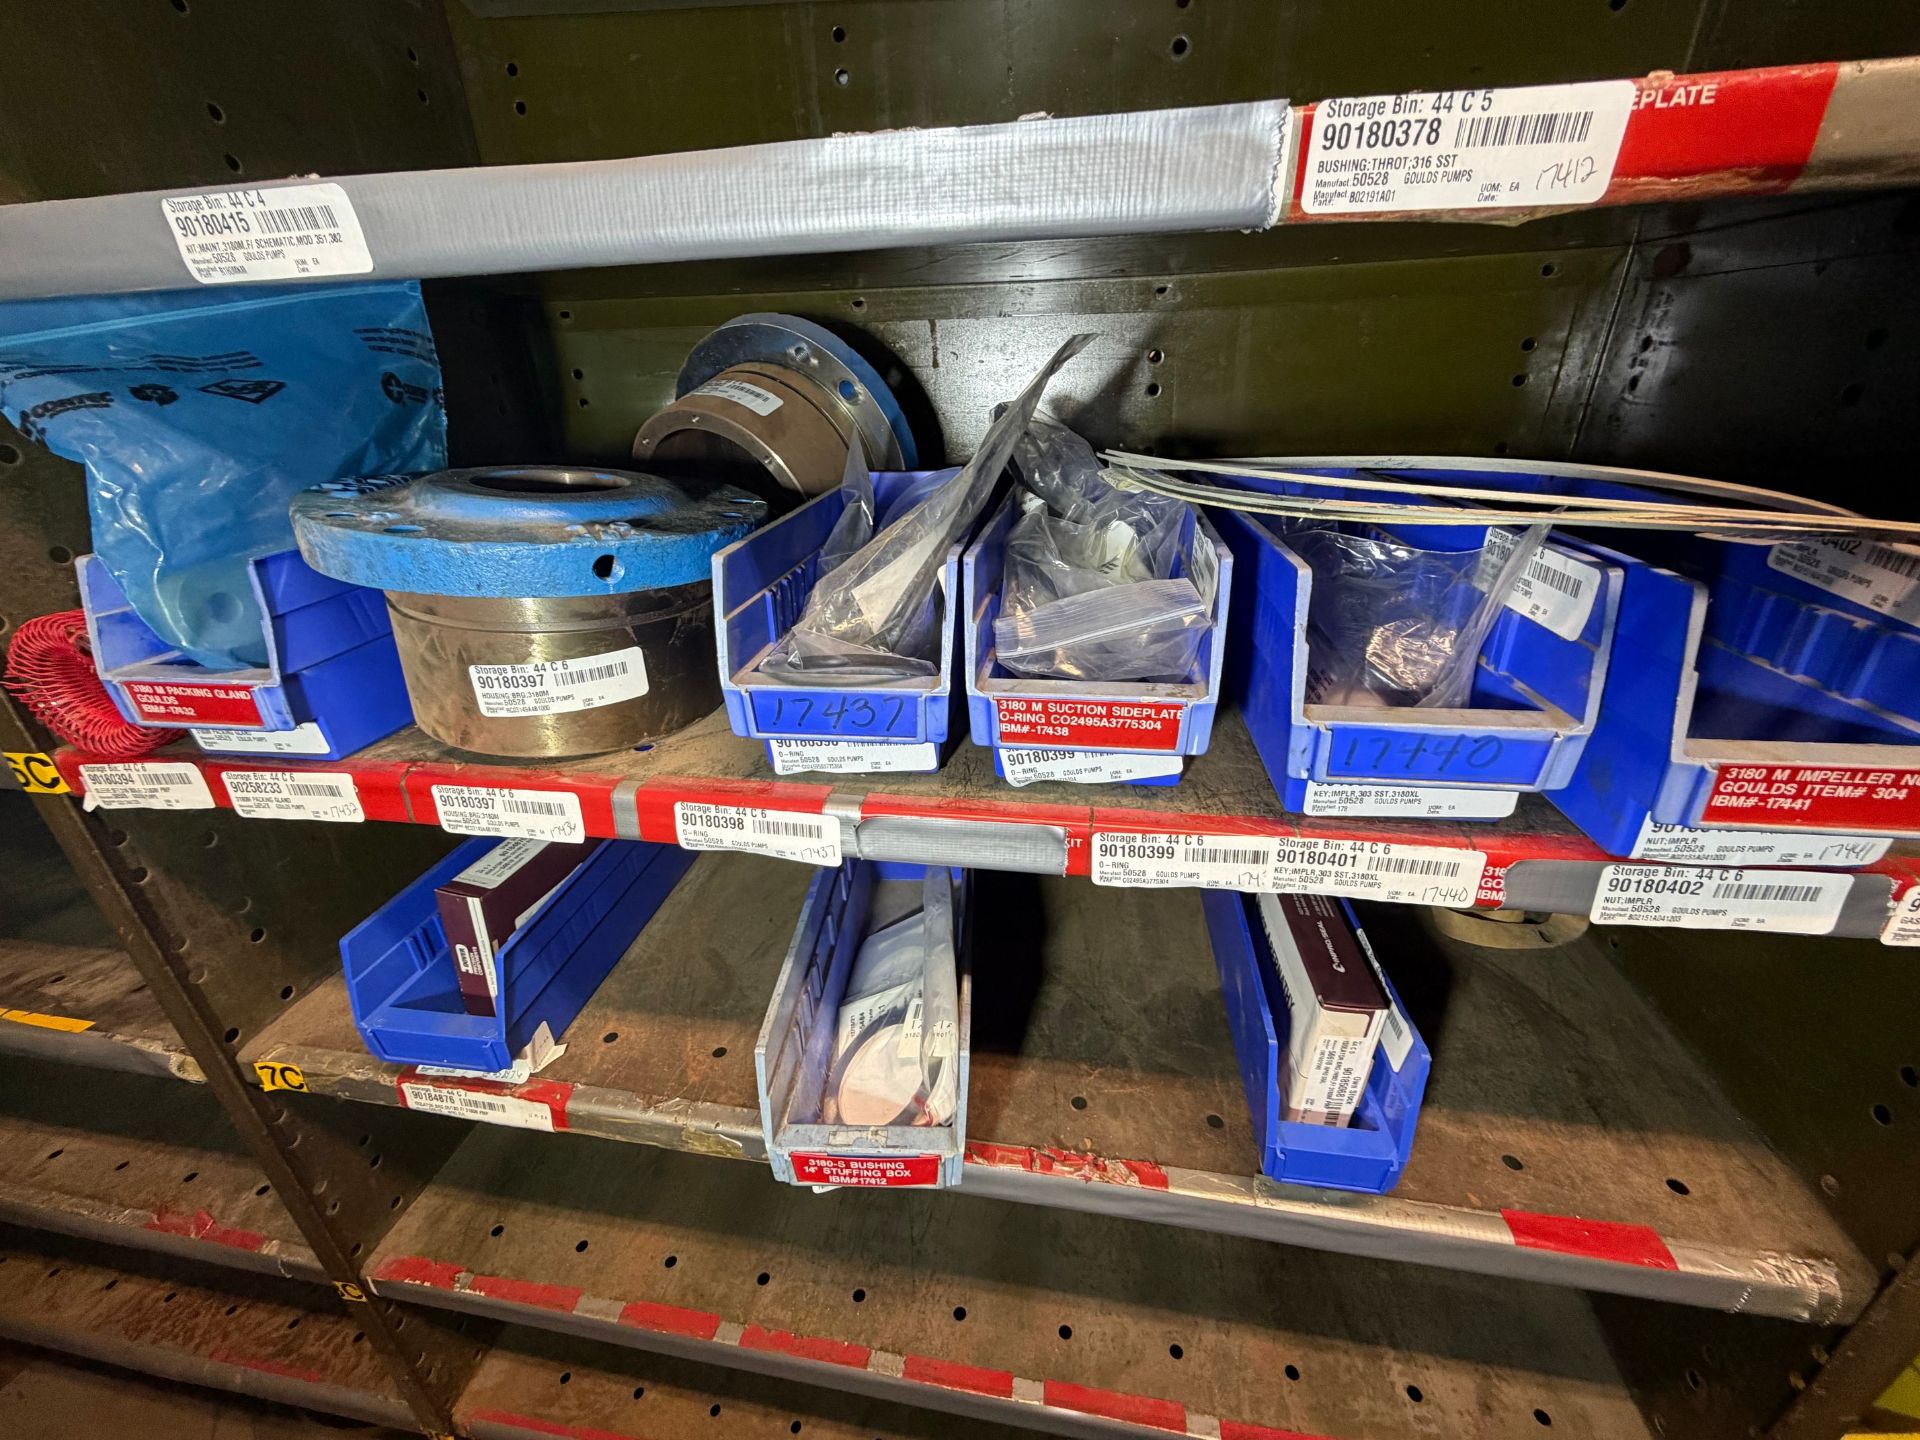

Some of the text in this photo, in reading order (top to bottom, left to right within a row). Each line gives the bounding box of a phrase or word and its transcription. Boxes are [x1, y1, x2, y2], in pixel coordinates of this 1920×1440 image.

[1326, 90, 1495, 119] Storage Bin: 44 C 5
[1322, 117, 1442, 151] 90180378
[1436, 154, 1458, 168] SST
[1352, 168, 1473, 187] 50528 GOULDS PUMPS
[1509, 181, 1520, 192] EA
[167, 190, 266, 214] Storage Bin: 44 C 4
[175, 211, 251, 238] 90180415
[474, 660, 569, 676] Storage Bin: 44 C 6
[478, 673, 545, 690] 90180397
[136, 694, 179, 705] GOULDS
[154, 685, 166, 695] M
[167, 685, 213, 698] PACKING
[214, 689, 252, 701] GLAND
[771, 694, 905, 733] 17437
[999, 700, 1184, 721] 3180 M SUCTION SIDEPLATE
[999, 712, 1046, 724] O-RING
[1007, 750, 1076, 767] 90180399
[1344, 733, 1504, 772] 17440
[226, 772, 251, 781] Storage
[269, 772, 280, 781] 44
[281, 772, 288, 782] C
[289, 773, 296, 782] 6
[1726, 767, 1766, 780] 3180
[1771, 769, 1792, 781] M
[1798, 769, 1897, 786] IMPELLER
[230, 781, 283, 794] 90258233
[436, 785, 515, 799] Storage Bin: 44 C 6
[1718, 781, 1909, 800] GOULDS ITEM# 304
[439, 794, 496, 810] 90180397
[1399, 797, 1422, 806] PUMPS
[680, 802, 767, 819] Storage Bin: 44 C 6
[682, 812, 745, 831] 90180398
[1100, 833, 1204, 846] Storage Bin: 44 C 6
[1278, 837, 1391, 855] Storage Bin: 44 C 6
[1099, 844, 1175, 860] 90180399
[1276, 850, 1357, 868] 90180401
[1156, 871, 1179, 879] GOULDS
[1179, 872, 1201, 880] PUMPS
[1612, 866, 1744, 881] Storage Bin: 44 C 6
[1334, 878, 1359, 887] GOULDS
[1360, 881, 1382, 889] PUMPS
[1607, 878, 1705, 896] 90180402
[1421, 886, 1469, 903] 17440
[258, 1065, 305, 1090] 7C
[412, 1090, 455, 1105] 90184876
[808, 1158, 905, 1171] 3180-S BUSHING
[823, 1167, 882, 1178] STUFFING
[886, 1169, 912, 1178] BOX
[829, 1175, 888, 1186] IBM#17412
